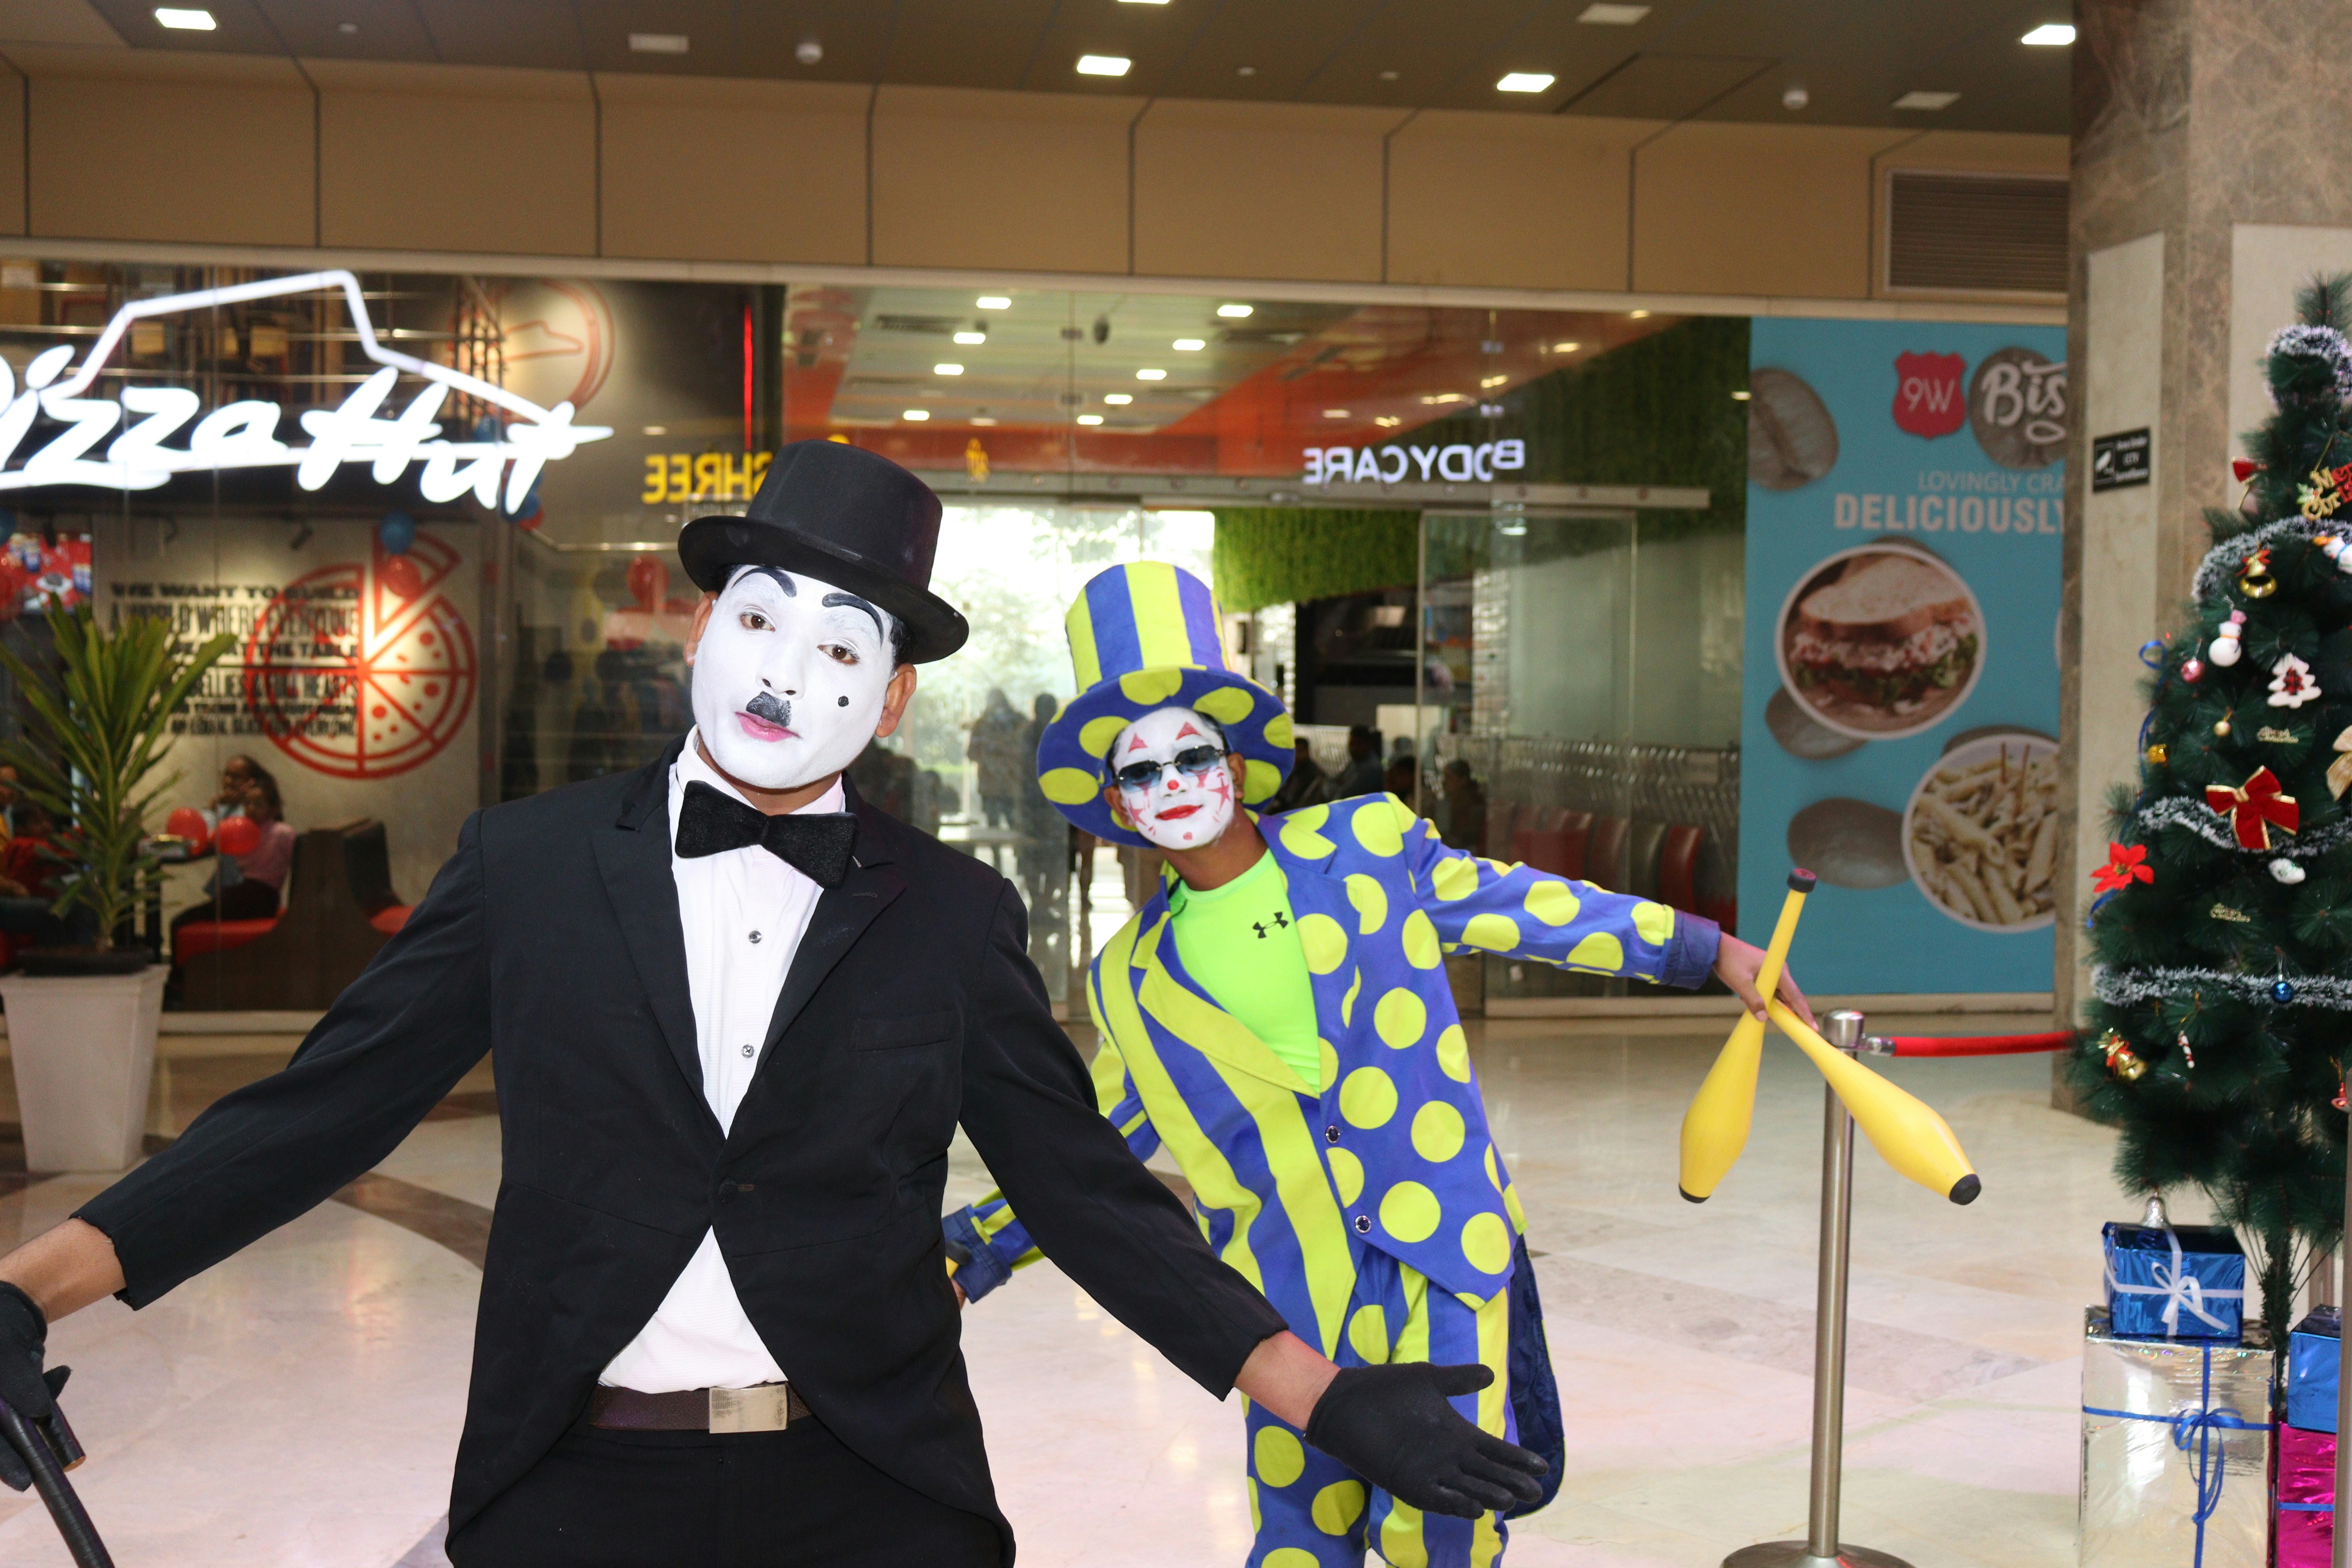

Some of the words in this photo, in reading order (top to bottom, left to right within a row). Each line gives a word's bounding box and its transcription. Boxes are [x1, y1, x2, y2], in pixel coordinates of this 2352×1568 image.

[1902, 377, 1956, 414] 9W
[297, 366, 614, 515] Hut
[1919, 471, 2020, 494] LOVINGLY
[111, 583, 153, 597] WE
[160, 584, 236, 598] WANT
[245, 585, 278, 599] TO
[197, 604, 261, 637] WHERE
[255, 642, 294, 657] THE
